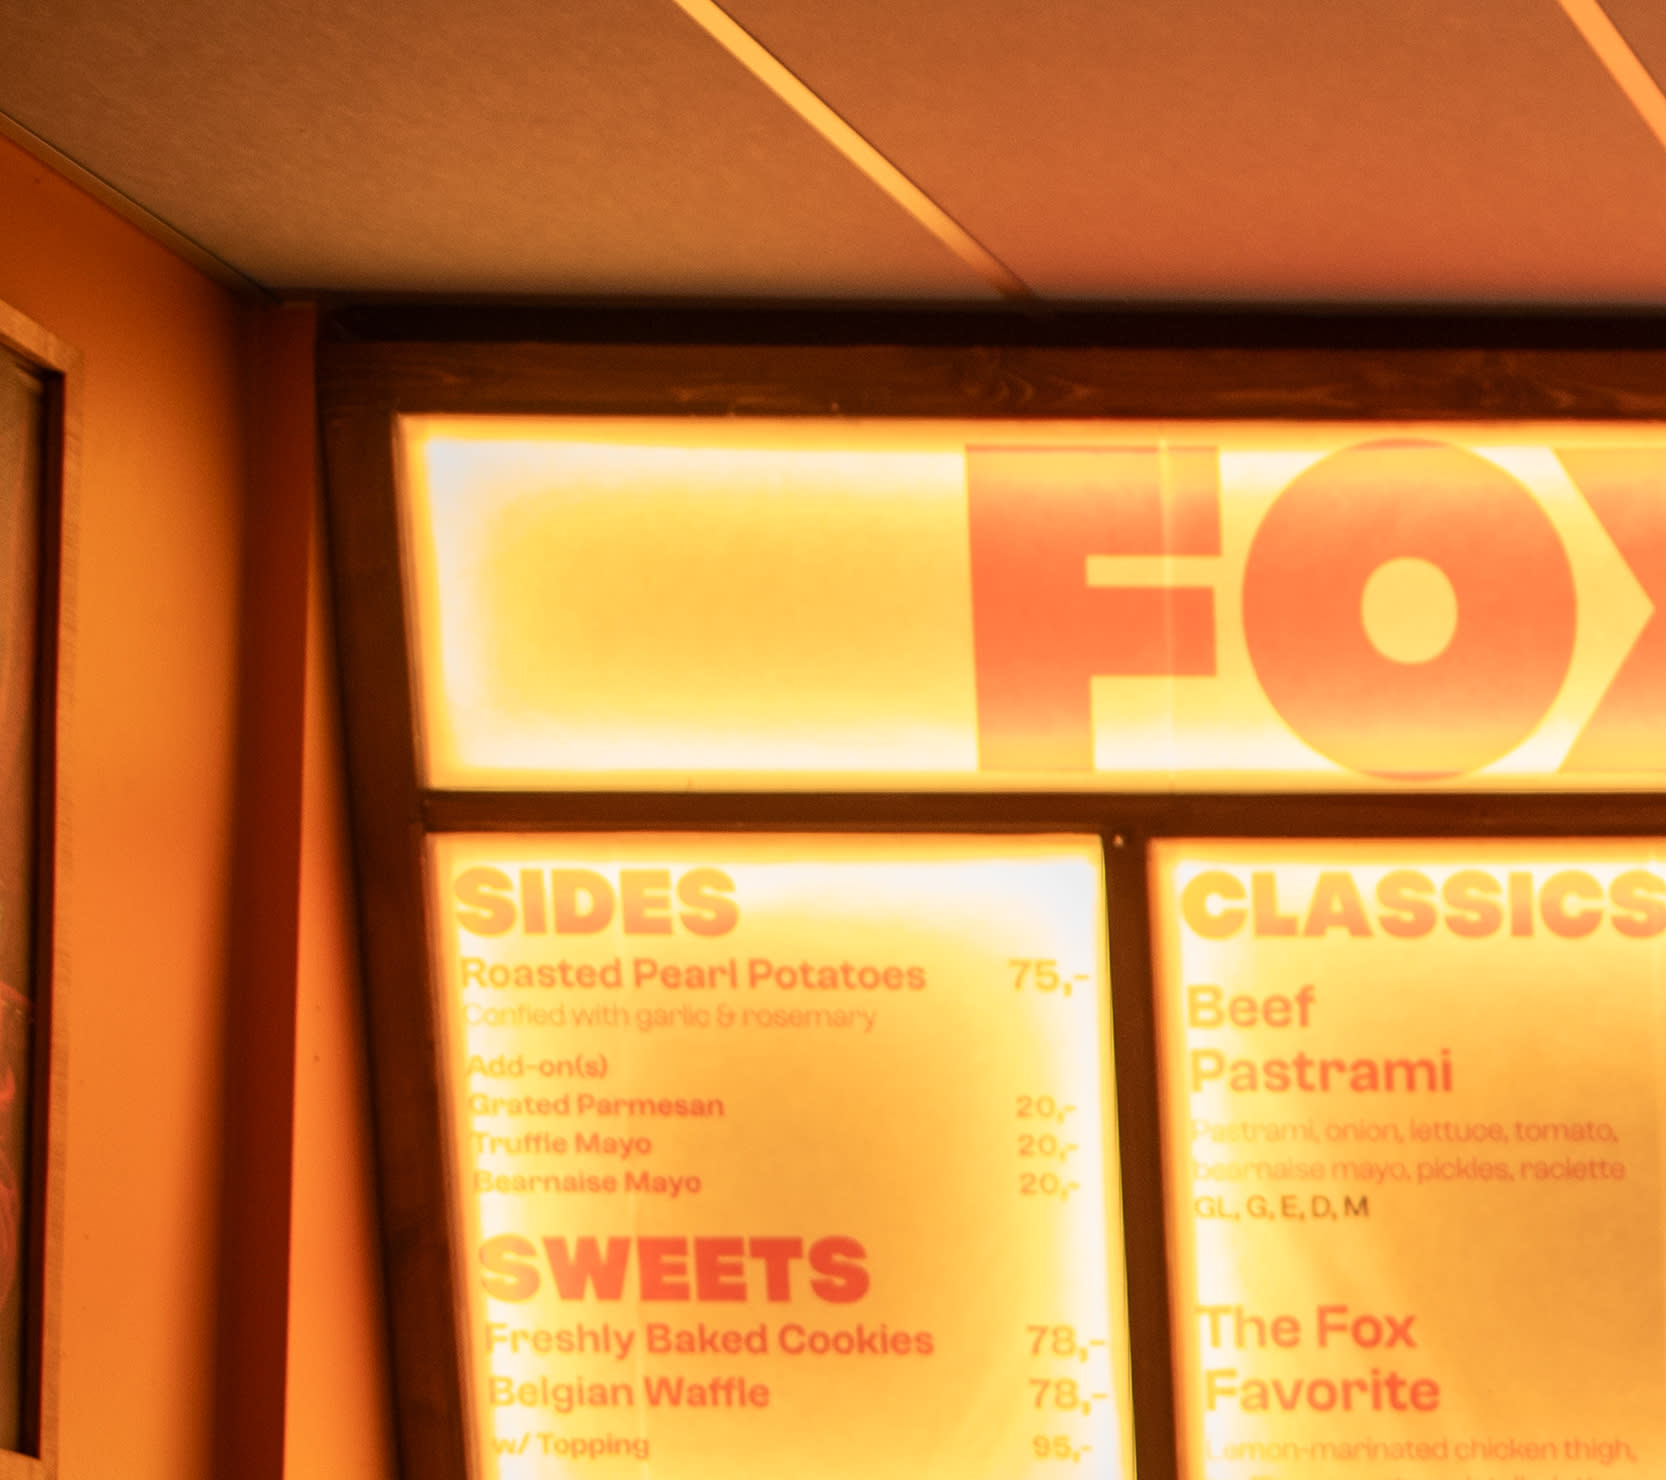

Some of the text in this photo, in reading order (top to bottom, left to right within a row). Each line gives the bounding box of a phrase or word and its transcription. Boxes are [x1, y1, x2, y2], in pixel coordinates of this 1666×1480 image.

[456, 867, 739, 938] SIDES
[463, 957, 1089, 997] Roasted Pearl Potatoes 75,-
[1187, 984, 1316, 1030] Beef
[470, 1053, 609, 1080] Add-on(s)
[1191, 1048, 1453, 1094] Pastrami
[472, 1093, 1077, 1123] Grated Parmesan 20,-
[475, 1131, 1079, 1162] Truffle Mayo 20,-
[473, 1170, 1080, 1200] Bearnaise Mayo 20,-
[479, 1234, 870, 1304] SWEETS
[490, 1322, 1106, 1363] Freshly Baked Cookies 78,-
[1197, 1304, 1417, 1350] The Fox
[492, 1376, 1108, 1416] Belgian Waffle 78,-
[1207, 1368, 1440, 1413] Favorite
[498, 1432, 1092, 1463] w/ Topping 95,-
